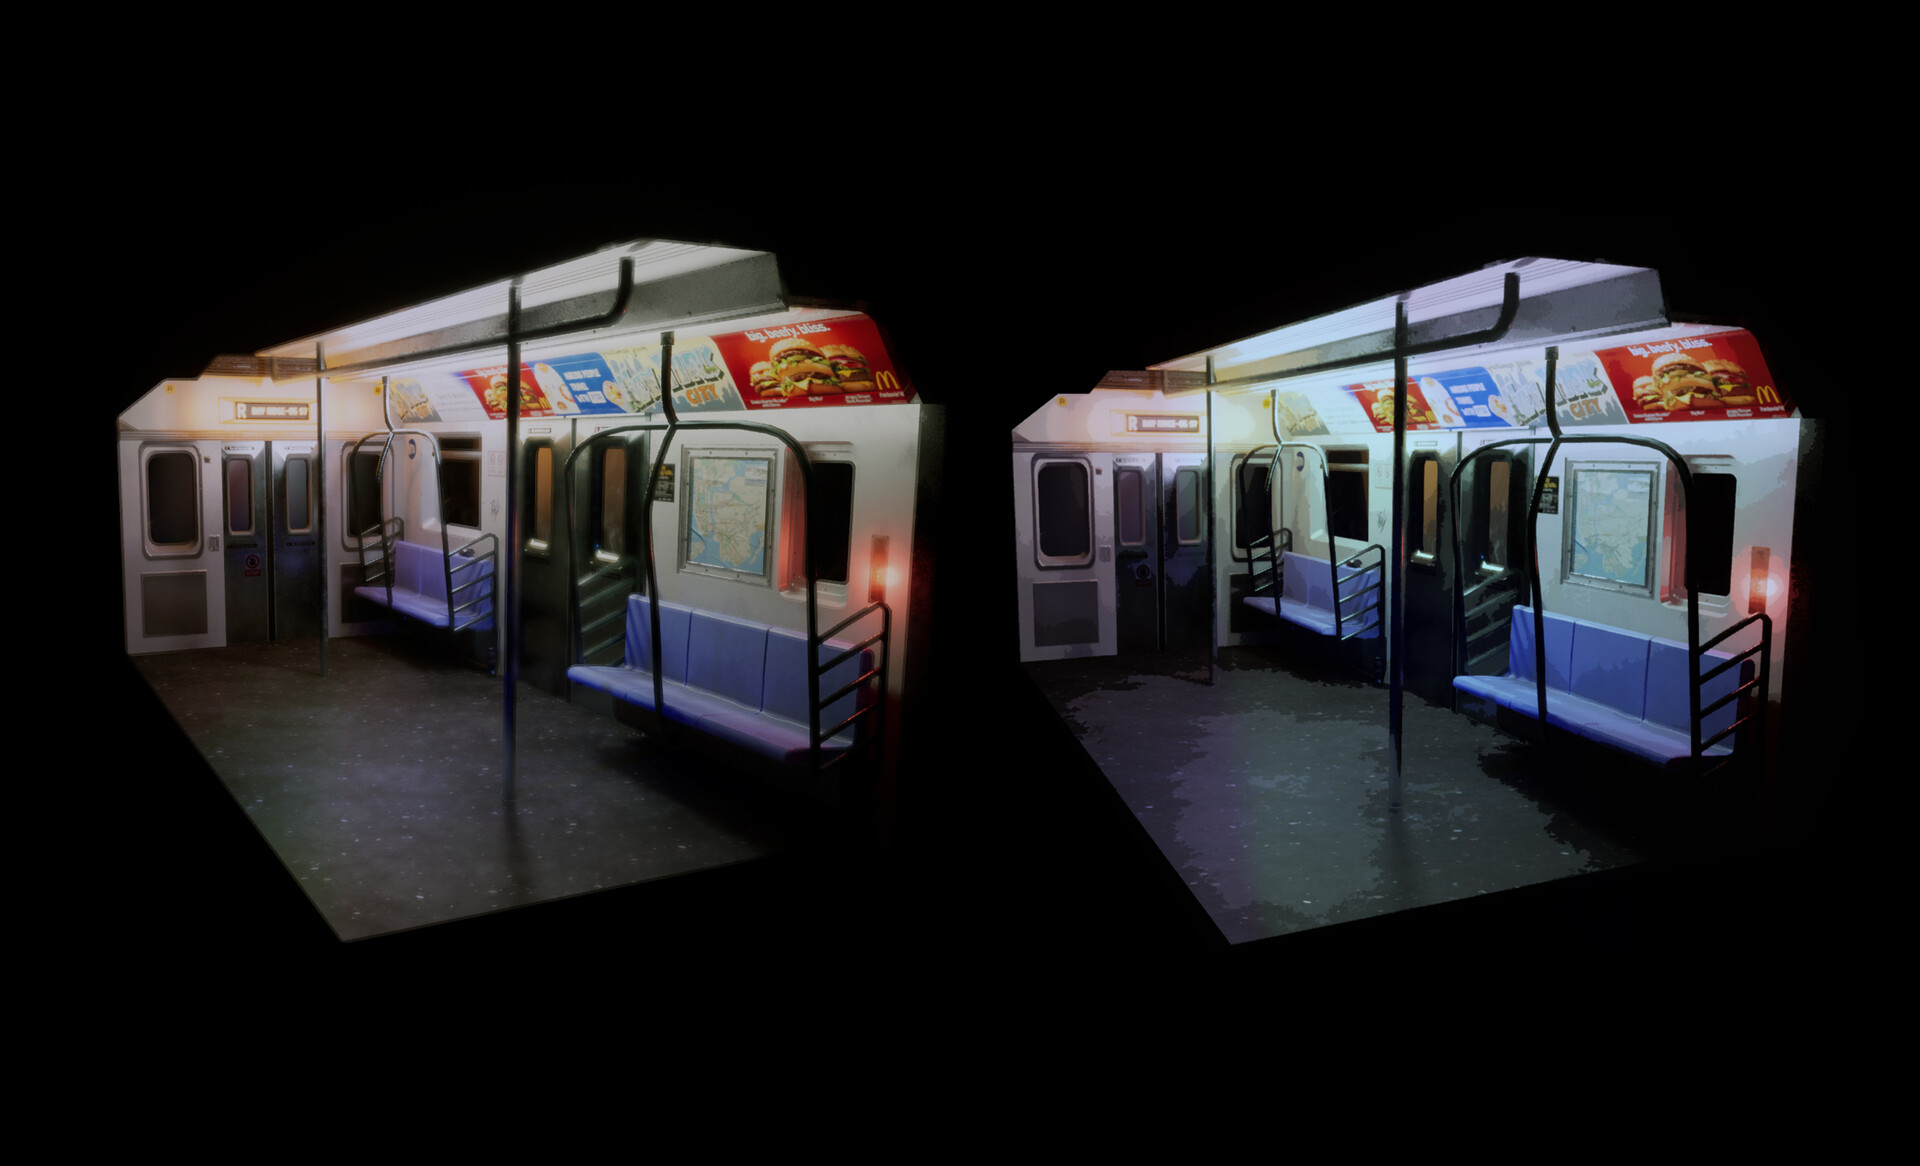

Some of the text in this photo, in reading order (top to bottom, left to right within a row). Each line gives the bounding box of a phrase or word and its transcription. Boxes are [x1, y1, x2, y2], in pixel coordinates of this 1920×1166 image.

[744, 323, 831, 343] big. beefy. bliss.
[686, 383, 718, 404] CITY
[237, 403, 247, 419] R
[1569, 398, 1601, 418] CITY
[1128, 415, 1138, 431] R
